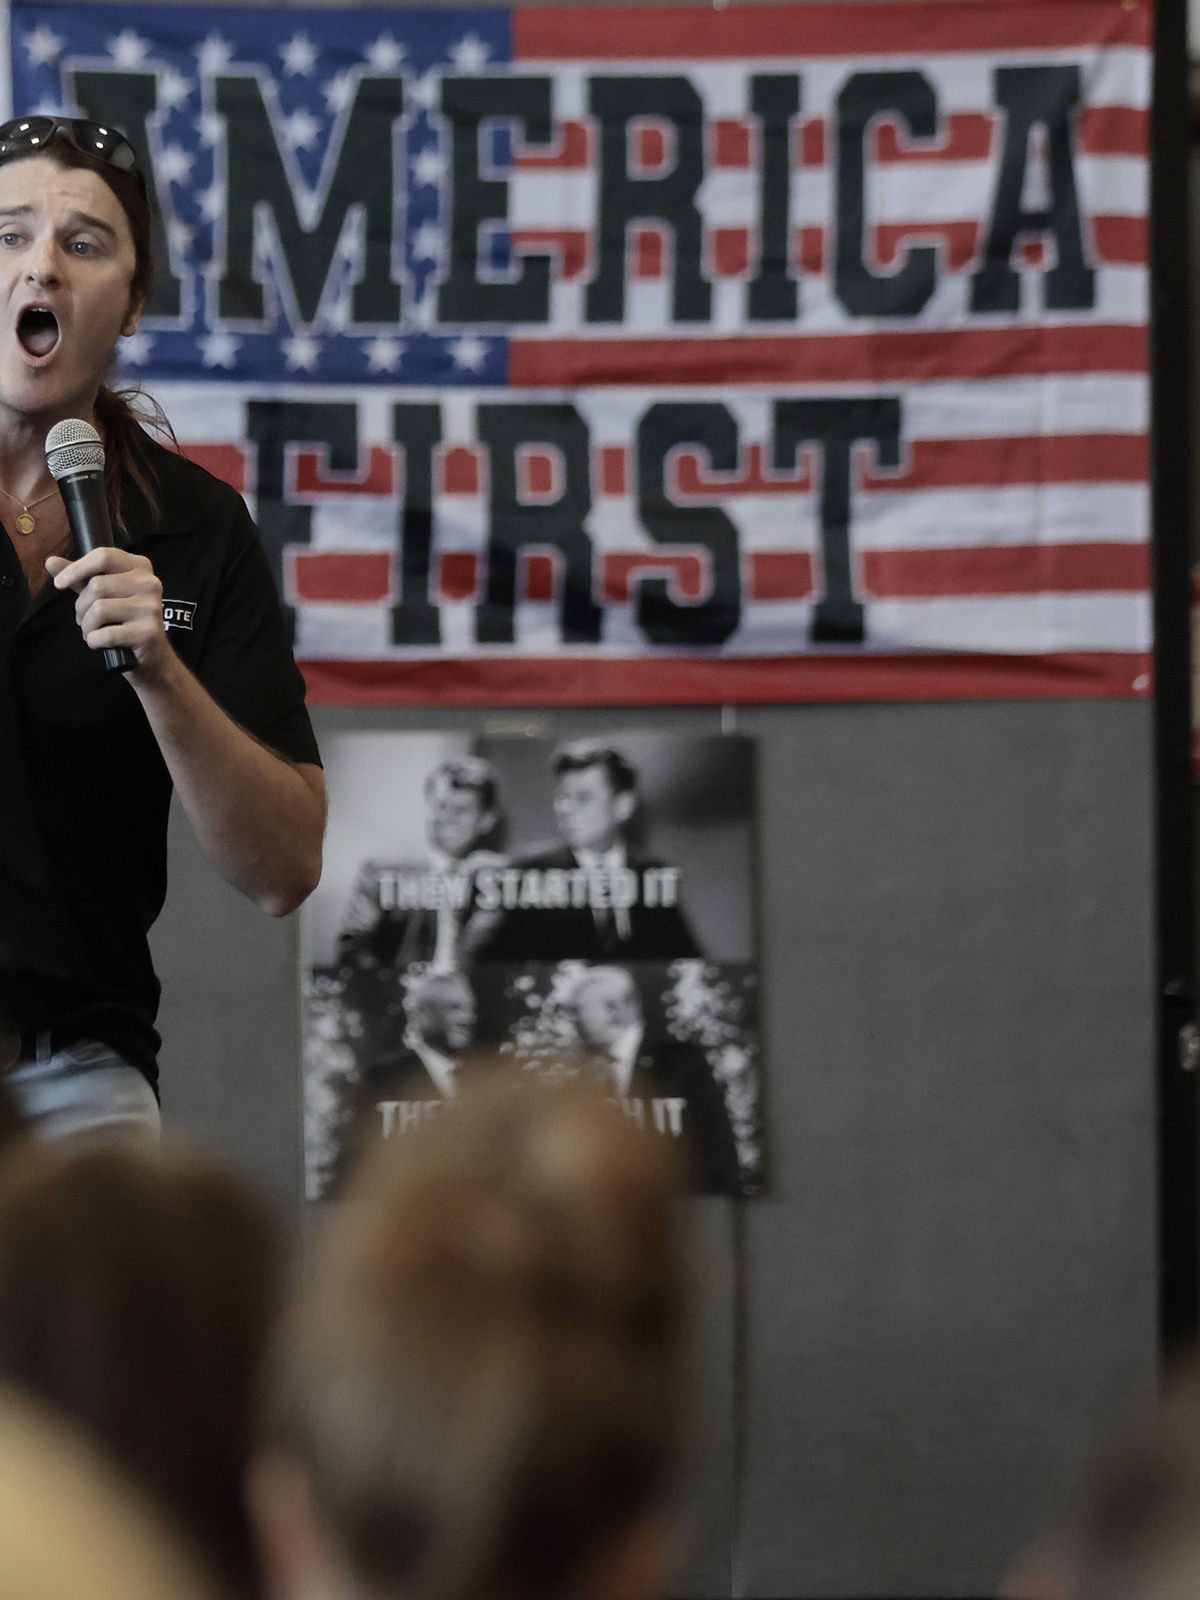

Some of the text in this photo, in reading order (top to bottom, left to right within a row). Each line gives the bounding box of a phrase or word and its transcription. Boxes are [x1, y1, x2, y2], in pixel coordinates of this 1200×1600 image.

[245, 396, 902, 647] FIRST
[162, 606, 191, 621] OTE
[474, 867, 639, 910] STARTED
[642, 866, 681, 908] IT
[652, 1097, 687, 1138] IT
